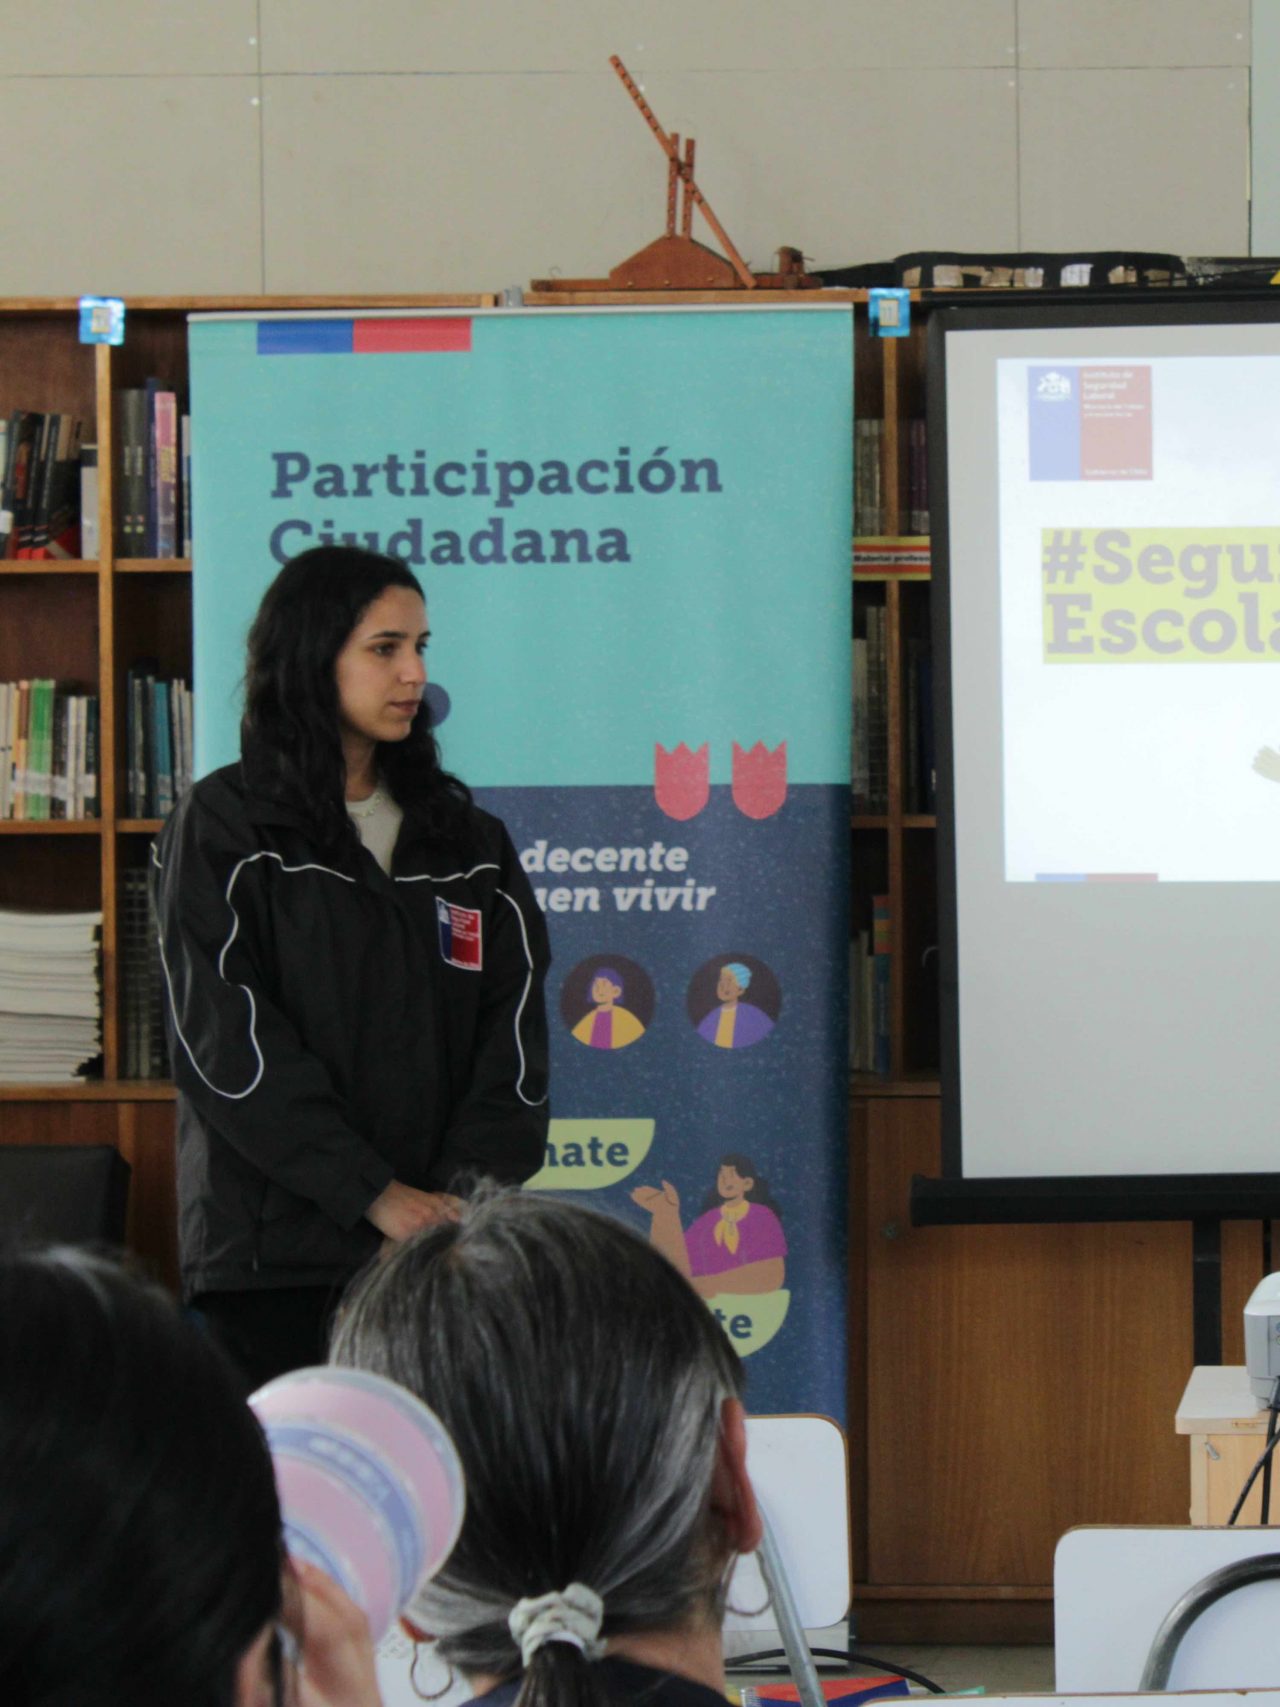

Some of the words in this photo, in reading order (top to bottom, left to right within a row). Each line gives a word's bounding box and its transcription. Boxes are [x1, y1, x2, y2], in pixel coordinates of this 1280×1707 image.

[270, 446, 723, 508] Participación
[268, 517, 632, 566] Ciudadana
[519, 839, 689, 873] decente
[612, 878, 717, 912] vivir
